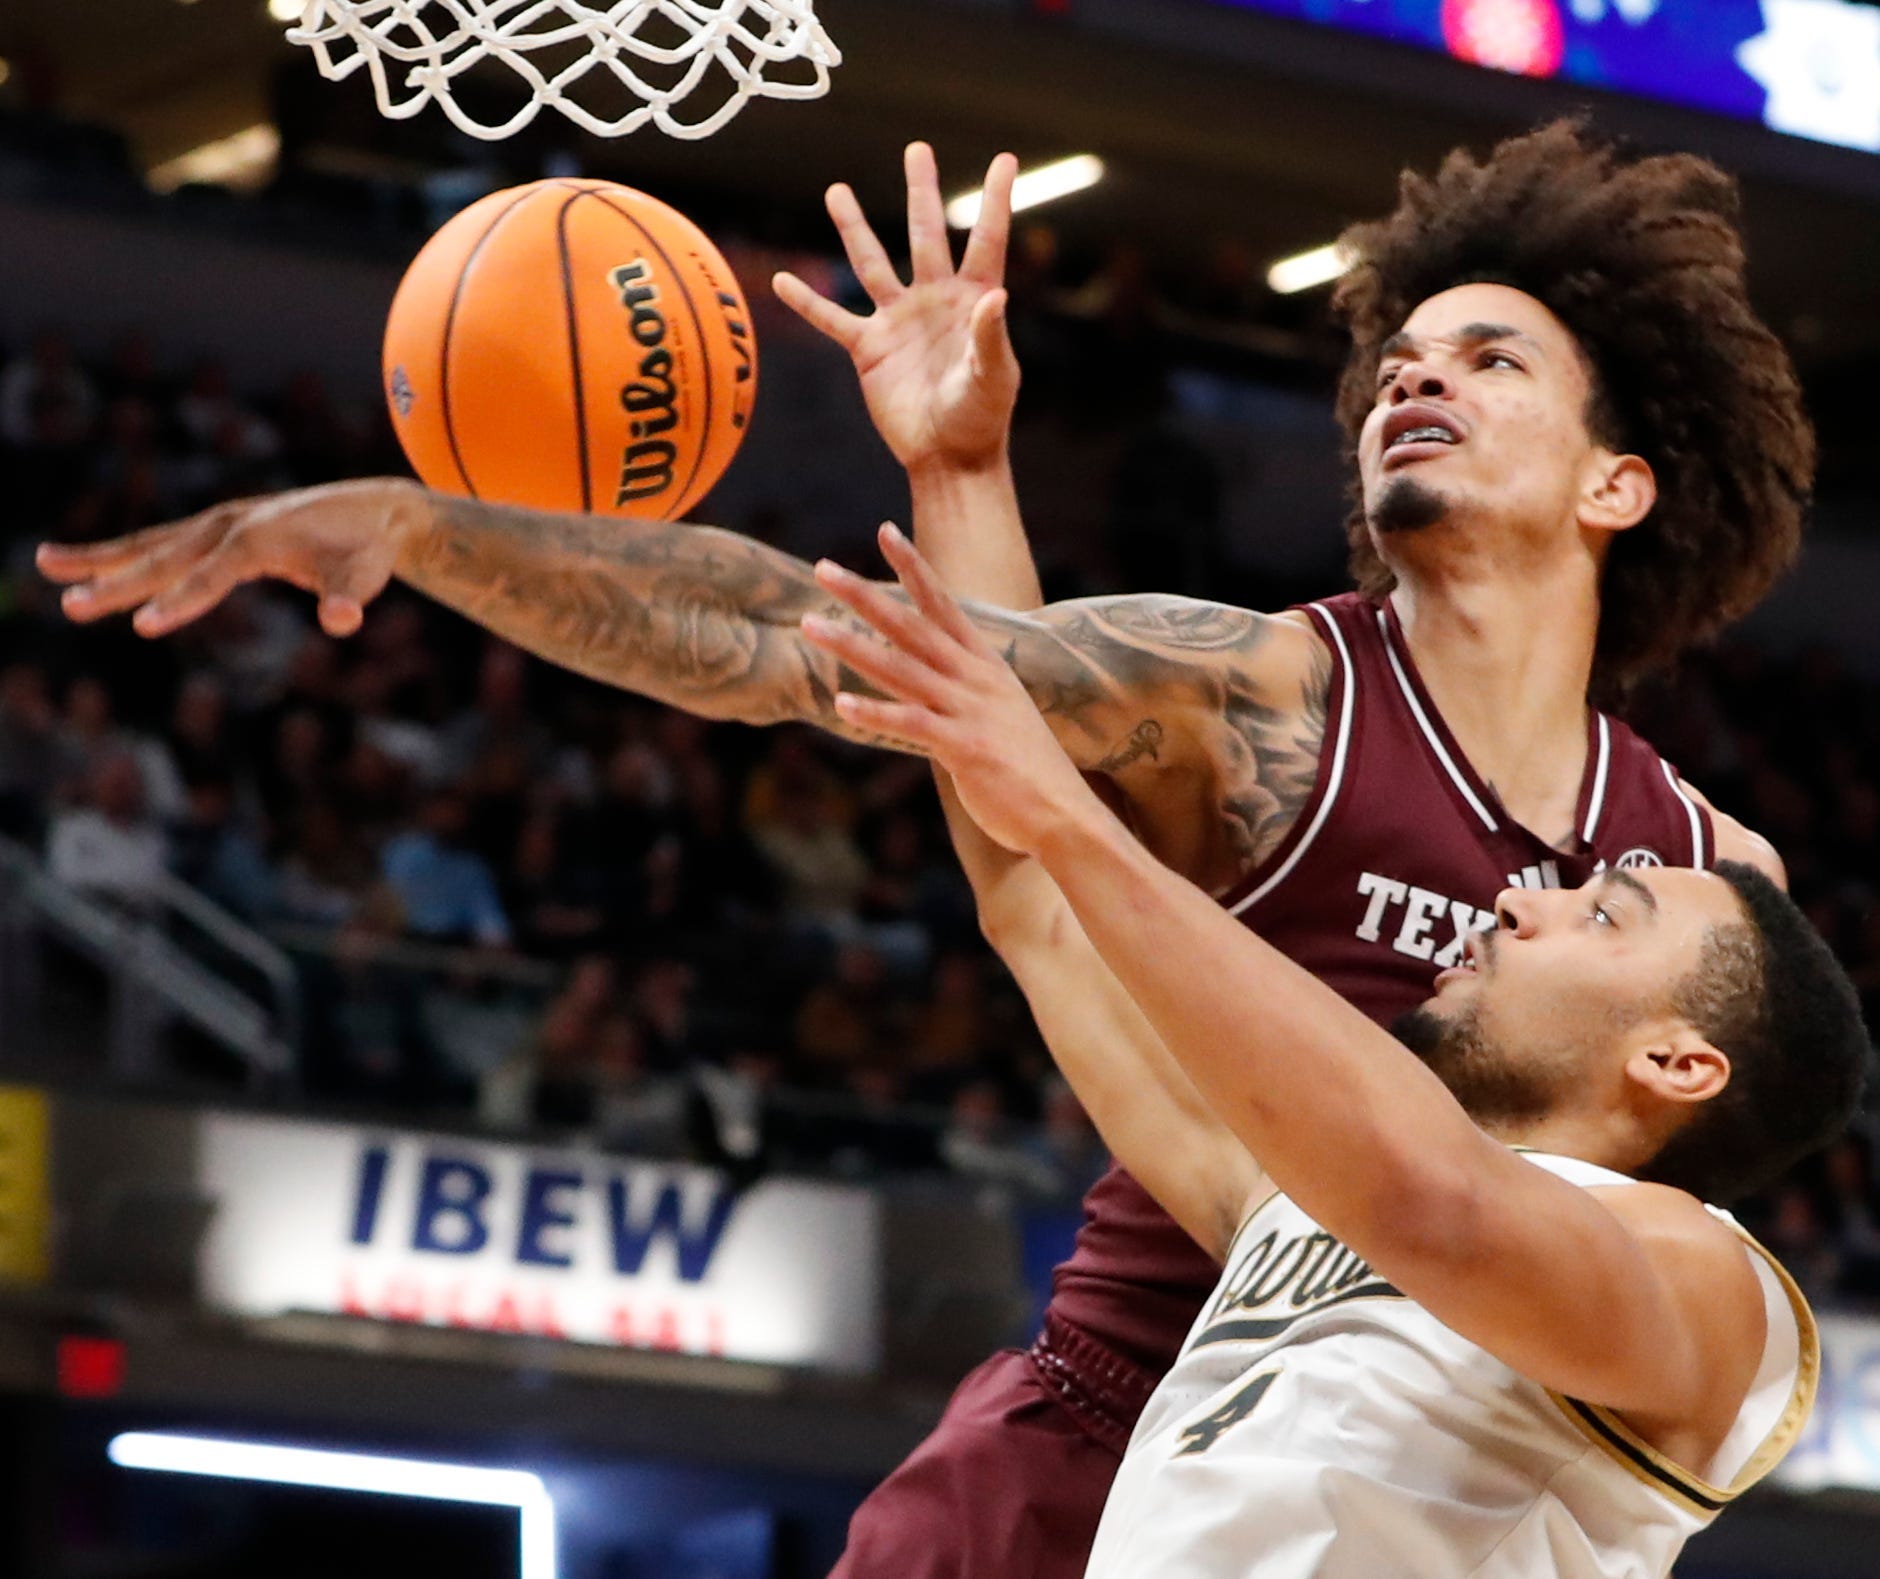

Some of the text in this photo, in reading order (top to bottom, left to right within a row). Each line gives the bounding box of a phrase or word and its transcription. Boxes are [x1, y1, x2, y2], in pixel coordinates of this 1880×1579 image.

[608, 257, 680, 508] Wilson
[349, 1147, 742, 1283] IBEW
[1168, 1367, 1284, 1460] 4
